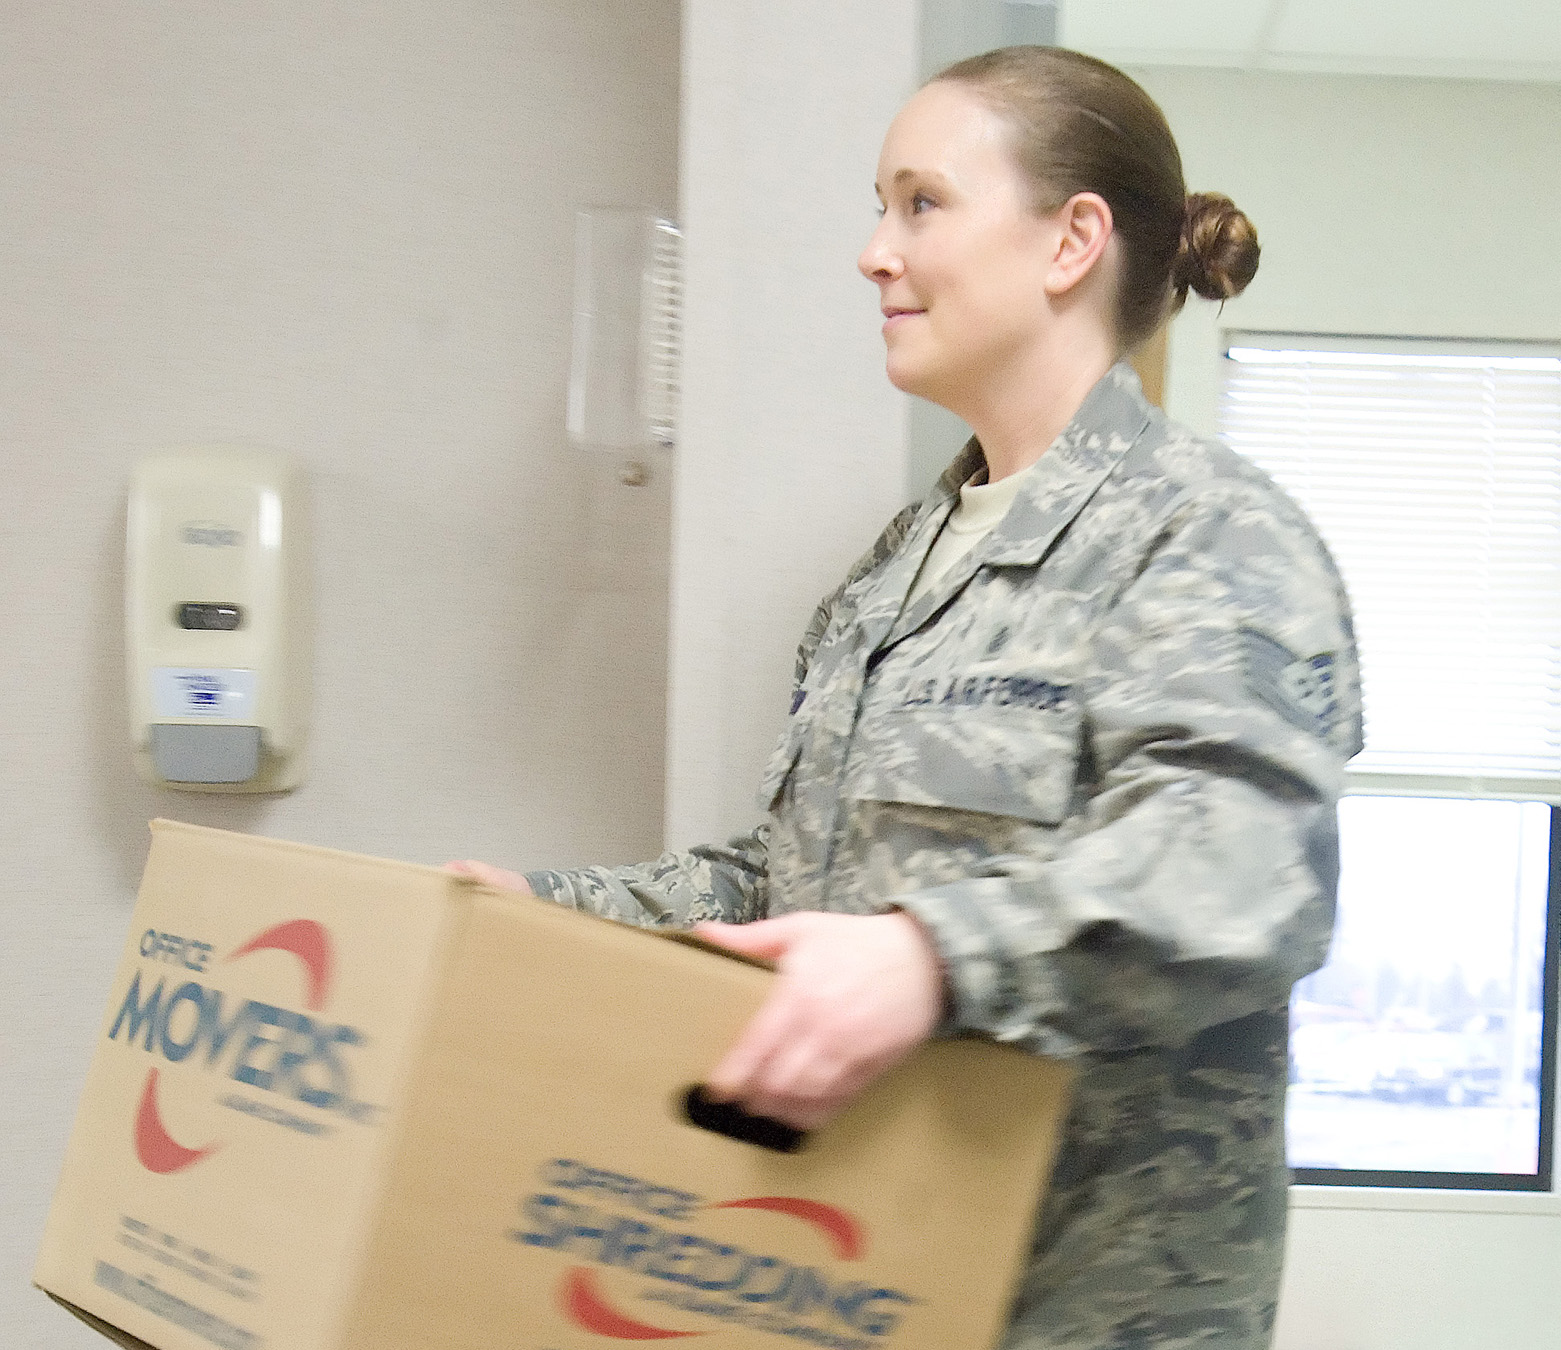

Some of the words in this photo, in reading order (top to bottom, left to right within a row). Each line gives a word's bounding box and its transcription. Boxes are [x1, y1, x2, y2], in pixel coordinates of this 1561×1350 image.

[139, 928, 214, 974] OFFICE
[107, 967, 370, 1110] MOVERS
[537, 1156, 704, 1222] OFFICE
[503, 1192, 922, 1337] SHREDDING
